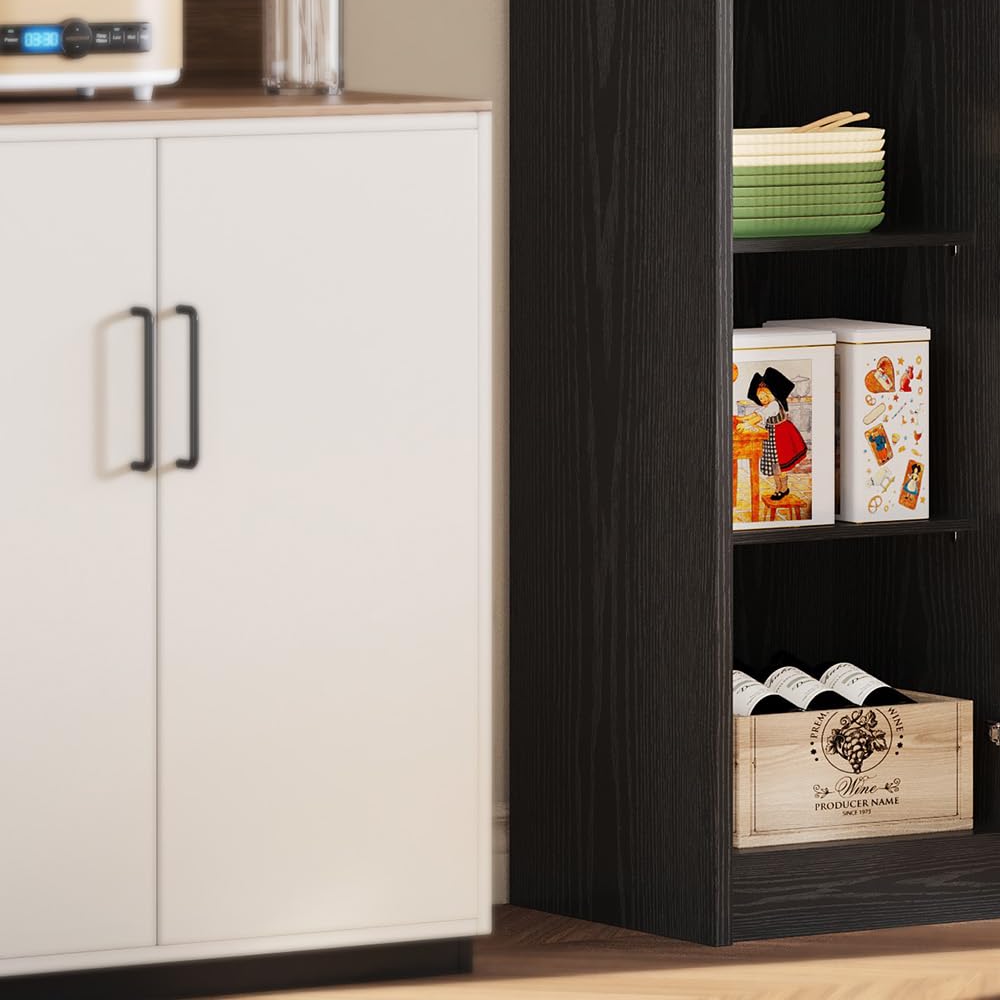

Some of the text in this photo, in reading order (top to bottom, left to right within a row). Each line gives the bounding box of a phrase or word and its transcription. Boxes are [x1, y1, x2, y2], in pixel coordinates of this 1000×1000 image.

[810, 707, 904, 739] PREM WINE
[834, 774, 879, 799] Wine
[815, 797, 900, 811] PRODUCER NAME
